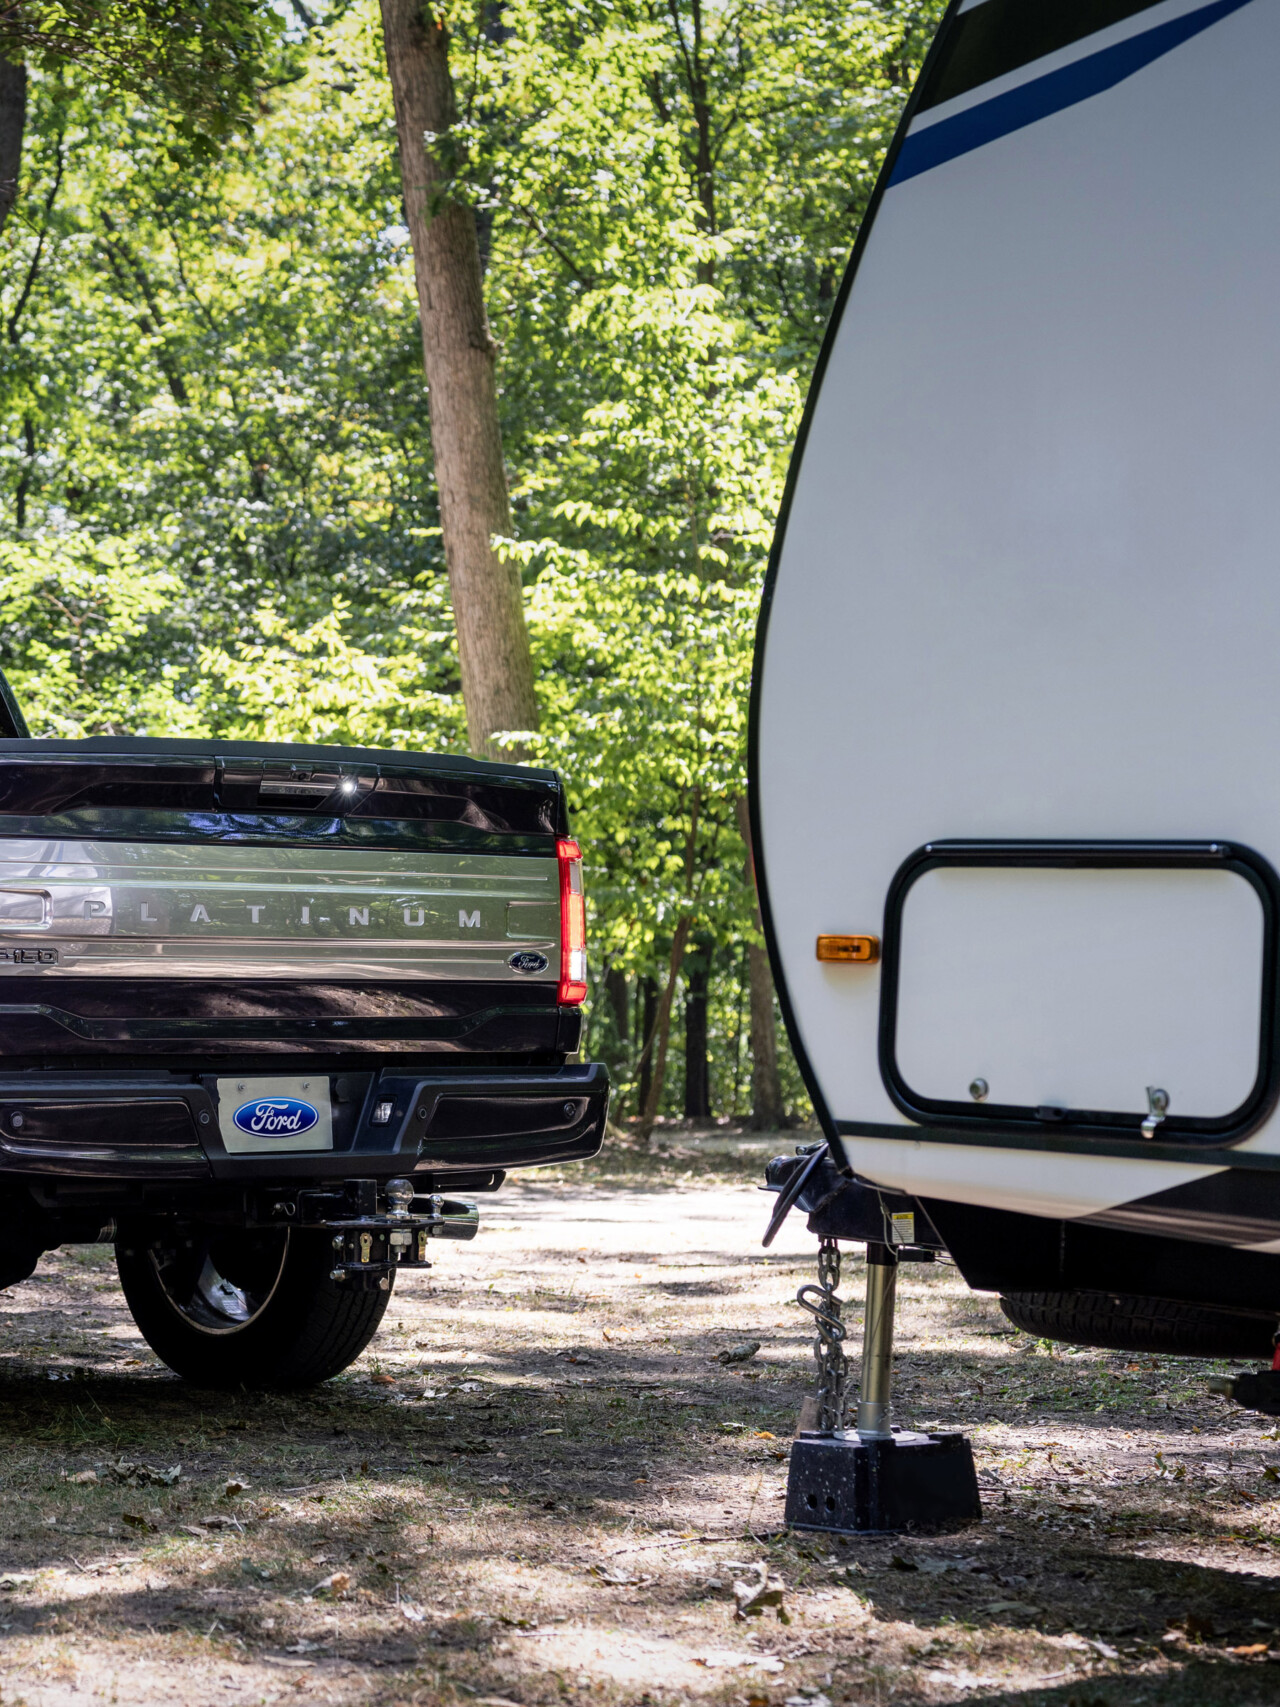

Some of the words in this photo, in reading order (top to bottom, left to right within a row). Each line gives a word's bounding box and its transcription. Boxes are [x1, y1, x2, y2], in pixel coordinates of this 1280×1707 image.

[83, 900, 481, 928] PLATINUM
[518, 954, 541, 969] Ford
[250, 1102, 302, 1131] Ford
